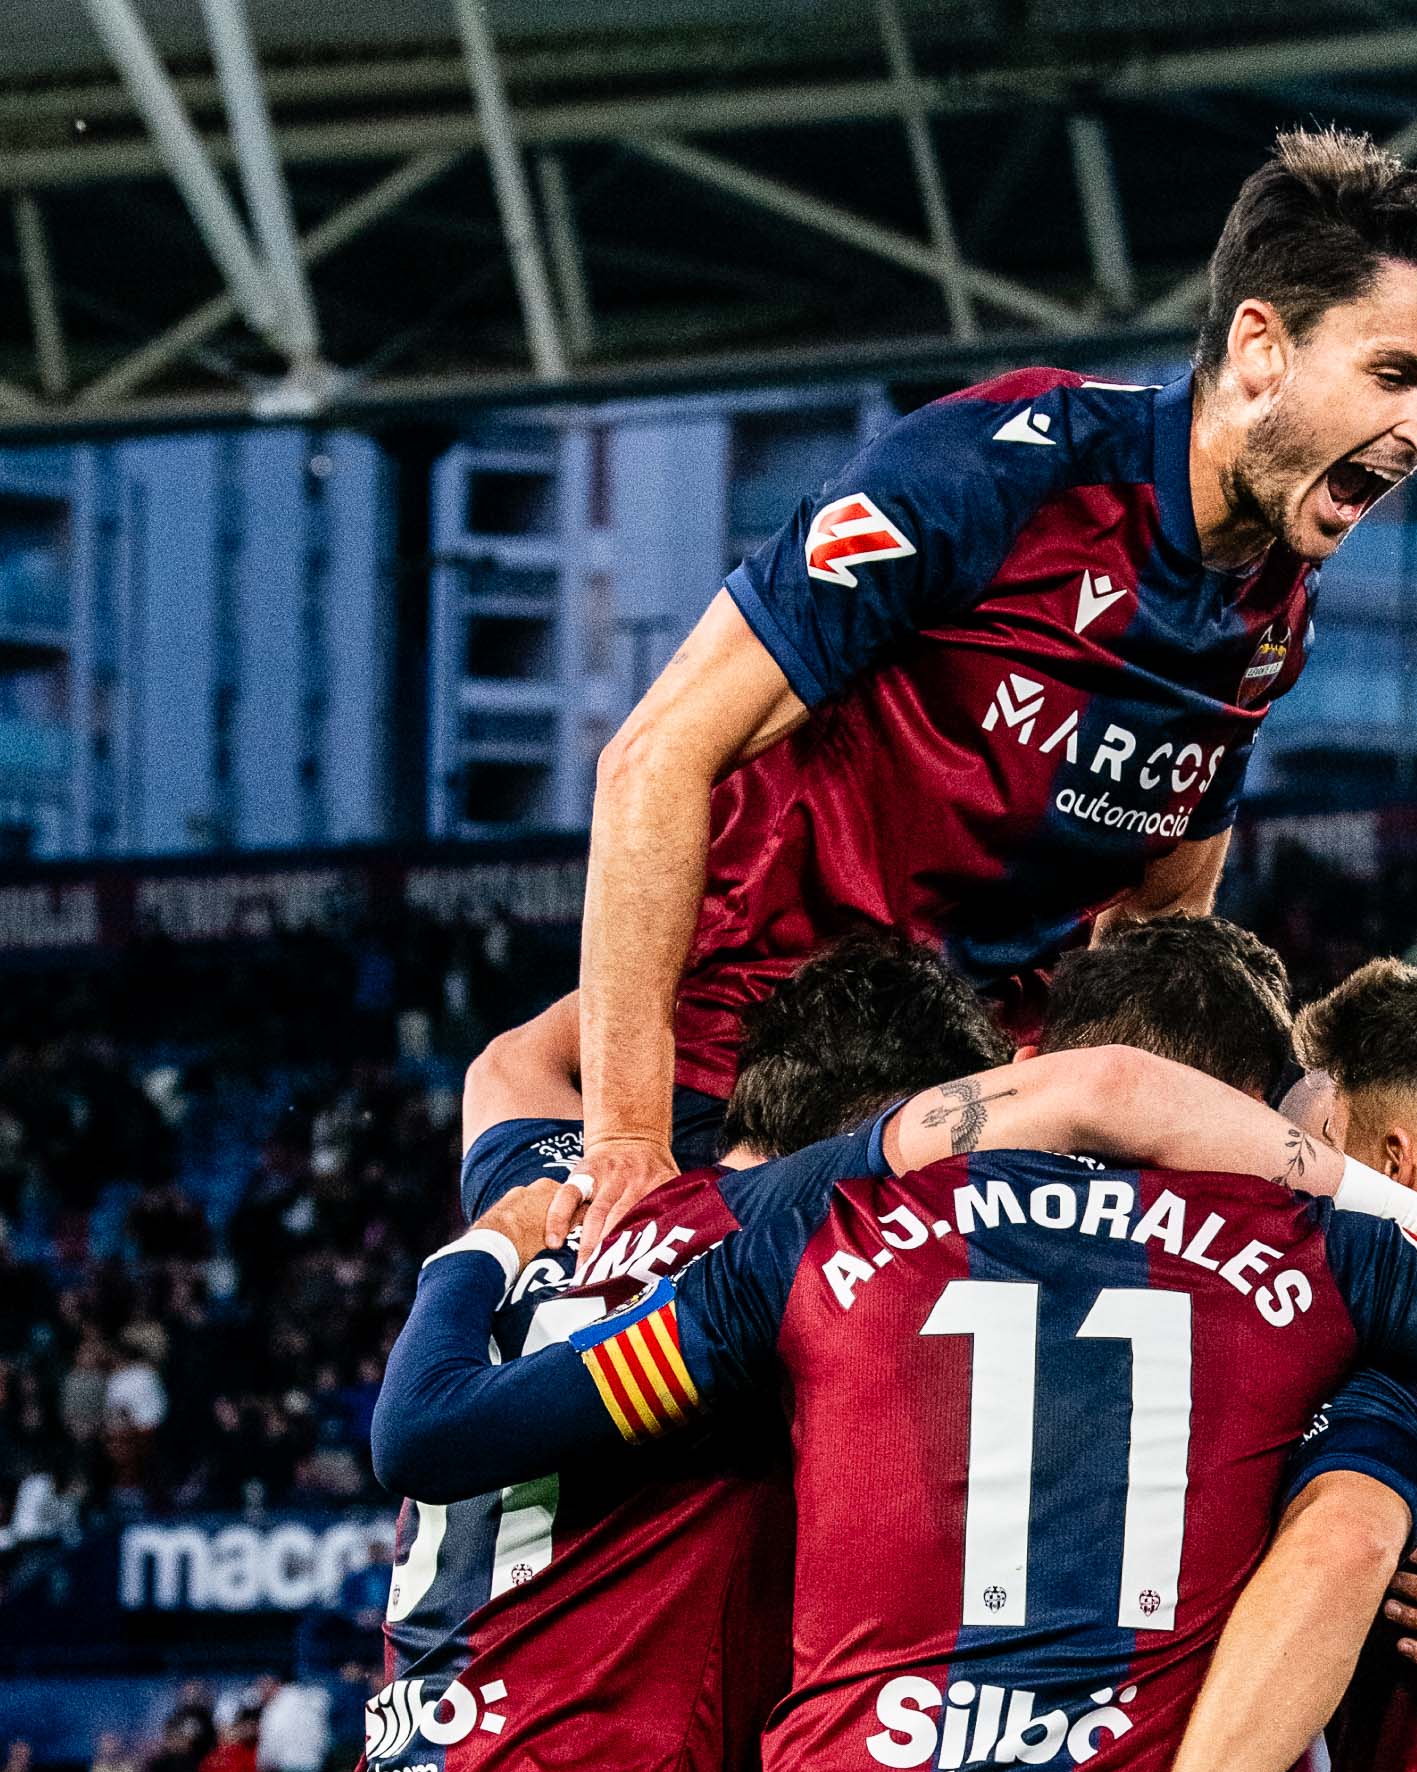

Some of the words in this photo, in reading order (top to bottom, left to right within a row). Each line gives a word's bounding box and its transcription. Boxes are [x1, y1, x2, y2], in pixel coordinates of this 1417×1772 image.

[980, 673, 1225, 794] MARCOS
[1055, 786, 1193, 838] automoció
[821, 1178, 1314, 1328] A.J.MORALES
[918, 1279, 1194, 1630] 11
